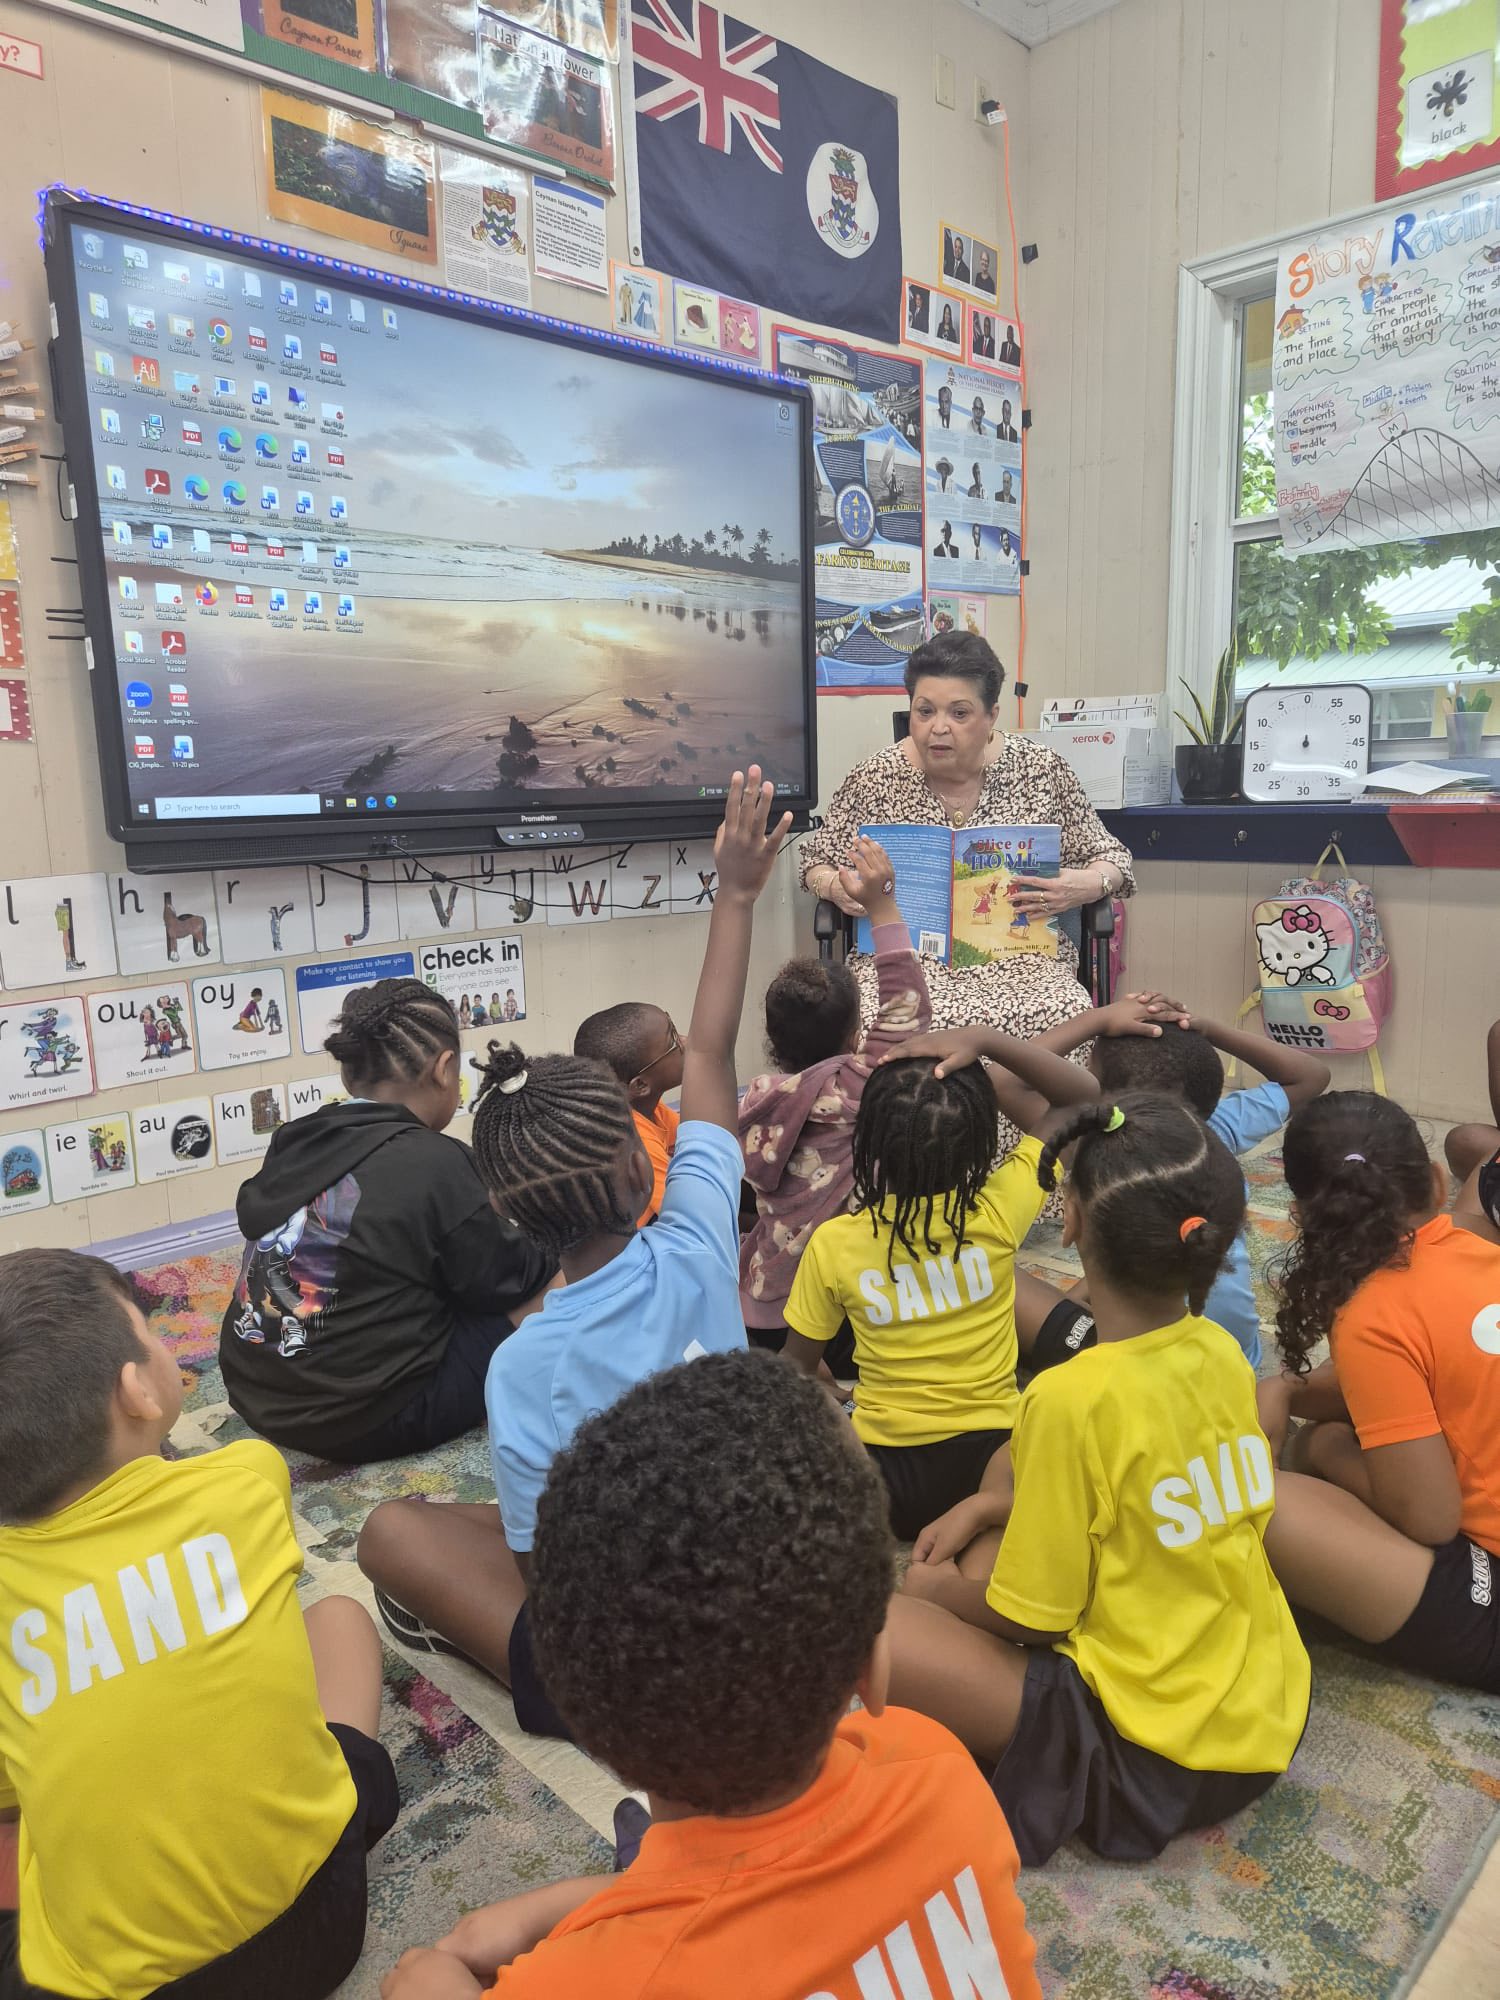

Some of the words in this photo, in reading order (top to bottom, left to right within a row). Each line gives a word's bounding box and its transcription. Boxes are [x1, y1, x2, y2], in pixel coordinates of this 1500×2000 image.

[279, 17, 323, 47] Cayman
[324, 33, 363, 60] Parrot
[1431, 122, 1467, 144] black
[535, 190, 557, 206] Cayman
[558, 198, 576, 212] Islands
[577, 206, 588, 217] Flag
[388, 231, 429, 253] Iguana
[1288, 228, 1384, 298] Story
[1374, 287, 1424, 309] CHARACTERS
[1464, 284, 1485, 295] The
[1376, 305, 1396, 318] The
[1402, 293, 1438, 318] people
[1467, 298, 1487, 311] the
[1298, 318, 1331, 335] SETTING
[1373, 320, 1385, 332] or
[1390, 305, 1439, 327] animals
[1372, 330, 1396, 345] that
[1402, 321, 1420, 336] act
[1424, 313, 1443, 330] out
[1468, 326, 1478, 335] is
[1284, 342, 1304, 354] The
[1309, 335, 1334, 349] time
[1380, 338, 1398, 352] the
[1283, 353, 1304, 368] and
[1308, 347, 1338, 363] place
[1454, 361, 1497, 379] SOLUTION
[1454, 383, 1475, 396] How
[1481, 376, 1499, 388] the
[1405, 394, 1428, 405] Events
[1466, 394, 1475, 403] is
[1287, 400, 1335, 419] HAPPENINGS
[1281, 420, 1298, 430] The
[1303, 409, 1336, 425] events
[1299, 421, 1337, 436] beginning
[1388, 424, 1399, 434] M
[1299, 437, 1327, 450] middle
[1301, 451, 1317, 462] end
[1303, 520, 1313, 532] B
[118, 656, 134, 664] Social
[134, 657, 157, 665] Studies
[164, 658, 187, 666] Acrobat
[1278, 701, 1285, 710] 5
[1304, 695, 1311, 704] 0
[1331, 698, 1343, 708] 55
[1257, 718, 1267, 728] 10
[1348, 714, 1361, 724] 50
[1072, 734, 1100, 744] xerox
[1249, 741, 1259, 750] 15
[1352, 737, 1365, 747] 45
[1252, 763, 1265, 773] 20
[1344, 760, 1358, 769] 40
[1268, 781, 1281, 790] 25
[1328, 778, 1341, 787] 35
[1296, 787, 1310, 796] 30
[177, 804, 193, 812] Type
[194, 803, 209, 811] here
[220, 803, 241, 811] search
[521, 813, 558, 824] Promethean
[976, 838, 1012, 850] Slice
[1018, 837, 1035, 850] of
[552, 854, 573, 874] w
[616, 850, 628, 868] z
[676, 847, 687, 866] x
[971, 853, 1041, 872] HOME
[403, 863, 418, 881] v
[480, 855, 495, 885] y
[118, 877, 144, 915] h
[227, 879, 240, 904] r
[6, 885, 19, 925] l
[423, 942, 495, 971] check
[501, 940, 520, 962] in
[303, 966, 323, 977] Make
[325, 964, 338, 975] eye
[338, 961, 364, 972] contact
[365, 960, 373, 968] to
[374, 957, 391, 967] show
[393, 957, 406, 967] you
[439, 968, 477, 983] Everyone
[477, 965, 493, 977] has
[335, 974, 347, 982] are
[348, 971, 377, 982] listening
[440, 979, 477, 993] Everyone
[478, 977, 494, 989] can
[200, 983, 235, 1009] oy
[97, 999, 138, 1024] ou
[1268, 1022, 1323, 1037] HELLO
[1272, 1034, 1325, 1048] KITTY
[228, 1052, 239, 1060] Toy
[126, 1068, 146, 1078] Shout
[147, 1067, 154, 1075] it
[155, 1066, 168, 1074] out.
[8, 1091, 30, 1101] Whirl
[32, 1088, 47, 1097] and
[49, 1084, 68, 1095] twirl.
[294, 1084, 321, 1104] wh
[222, 1101, 246, 1120] kn
[140, 1115, 166, 1134] au
[56, 1132, 77, 1153] ie
[858, 1246, 994, 1326] SAND
[11, 1533, 249, 1716] SAND
